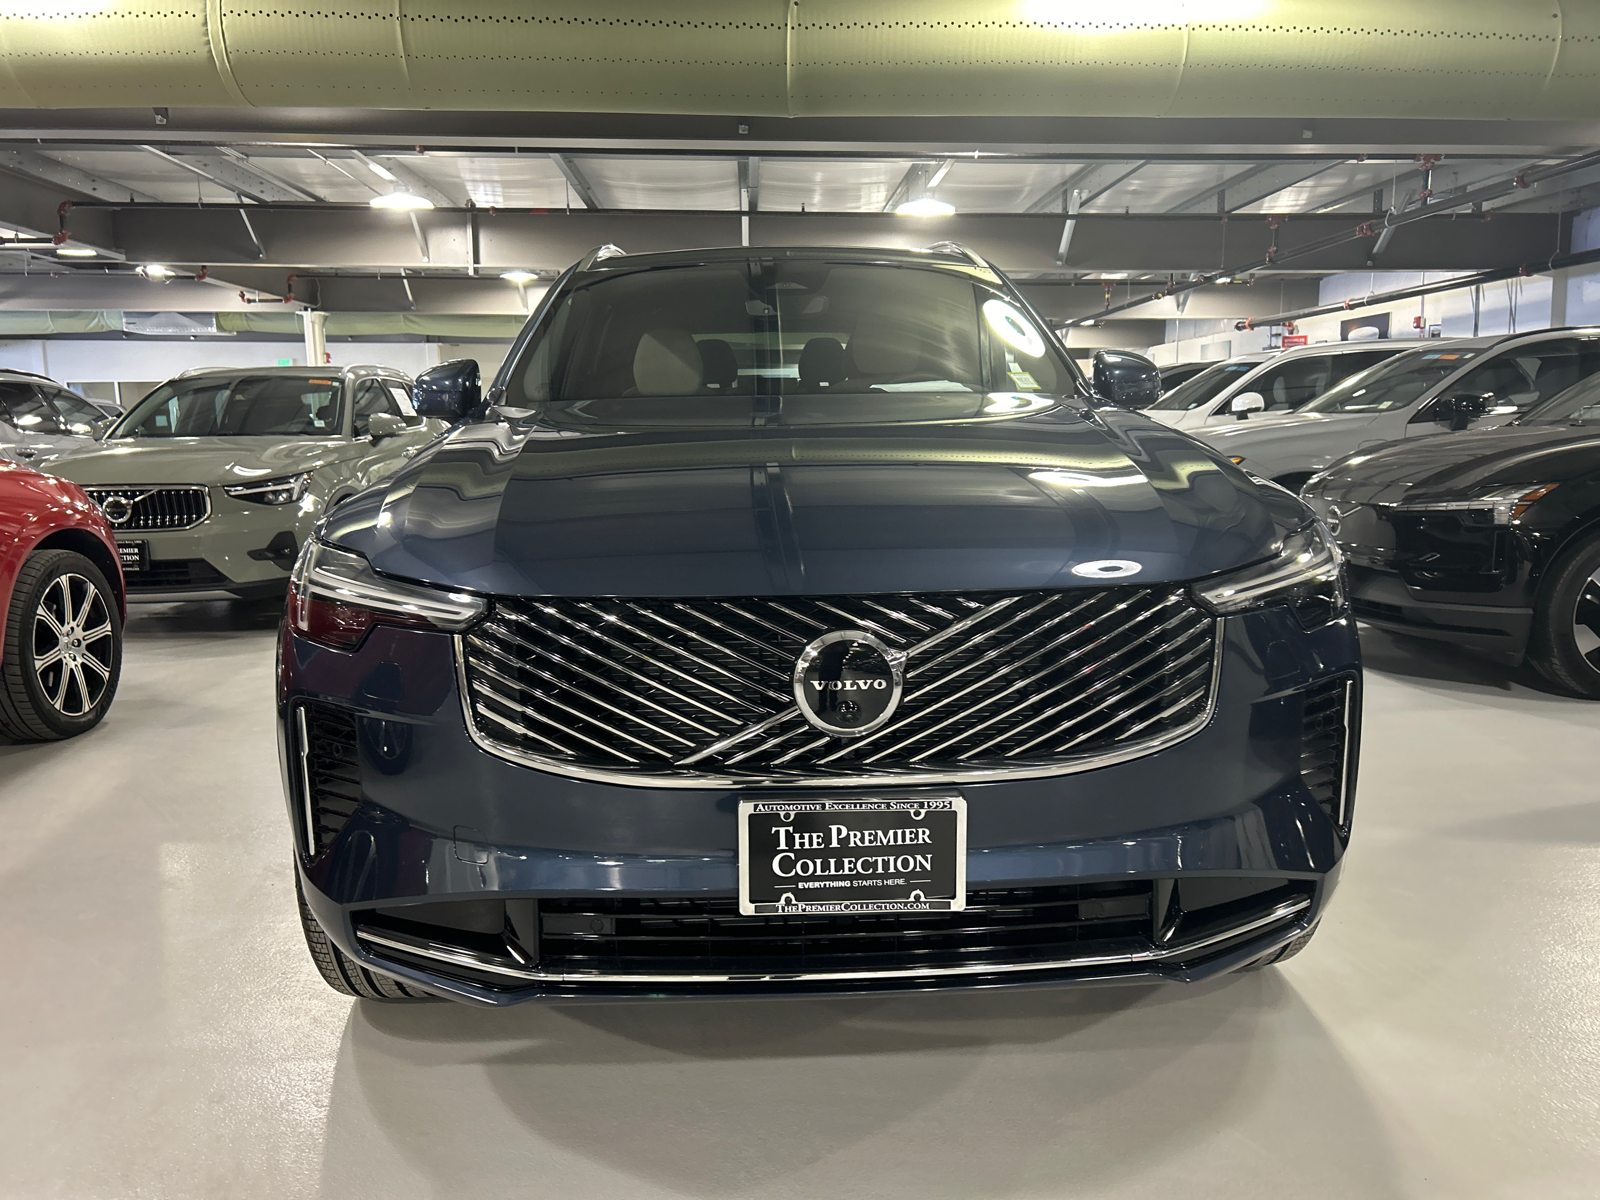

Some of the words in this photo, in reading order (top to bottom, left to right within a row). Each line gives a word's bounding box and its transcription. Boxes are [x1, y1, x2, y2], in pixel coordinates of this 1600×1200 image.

[810, 679, 887, 691] VOLVO
[755, 803, 822, 812] AUTOMOTIVE
[825, 802, 887, 811] EXCELLENCE
[890, 801, 920, 810] SINCE
[923, 801, 951, 809] 1995
[771, 825, 825, 850] THE
[829, 824, 933, 848] PREMIER
[771, 852, 933, 878] COLLECTION
[798, 880, 851, 889] EVERYTHING
[852, 879, 882, 887] STARTS
